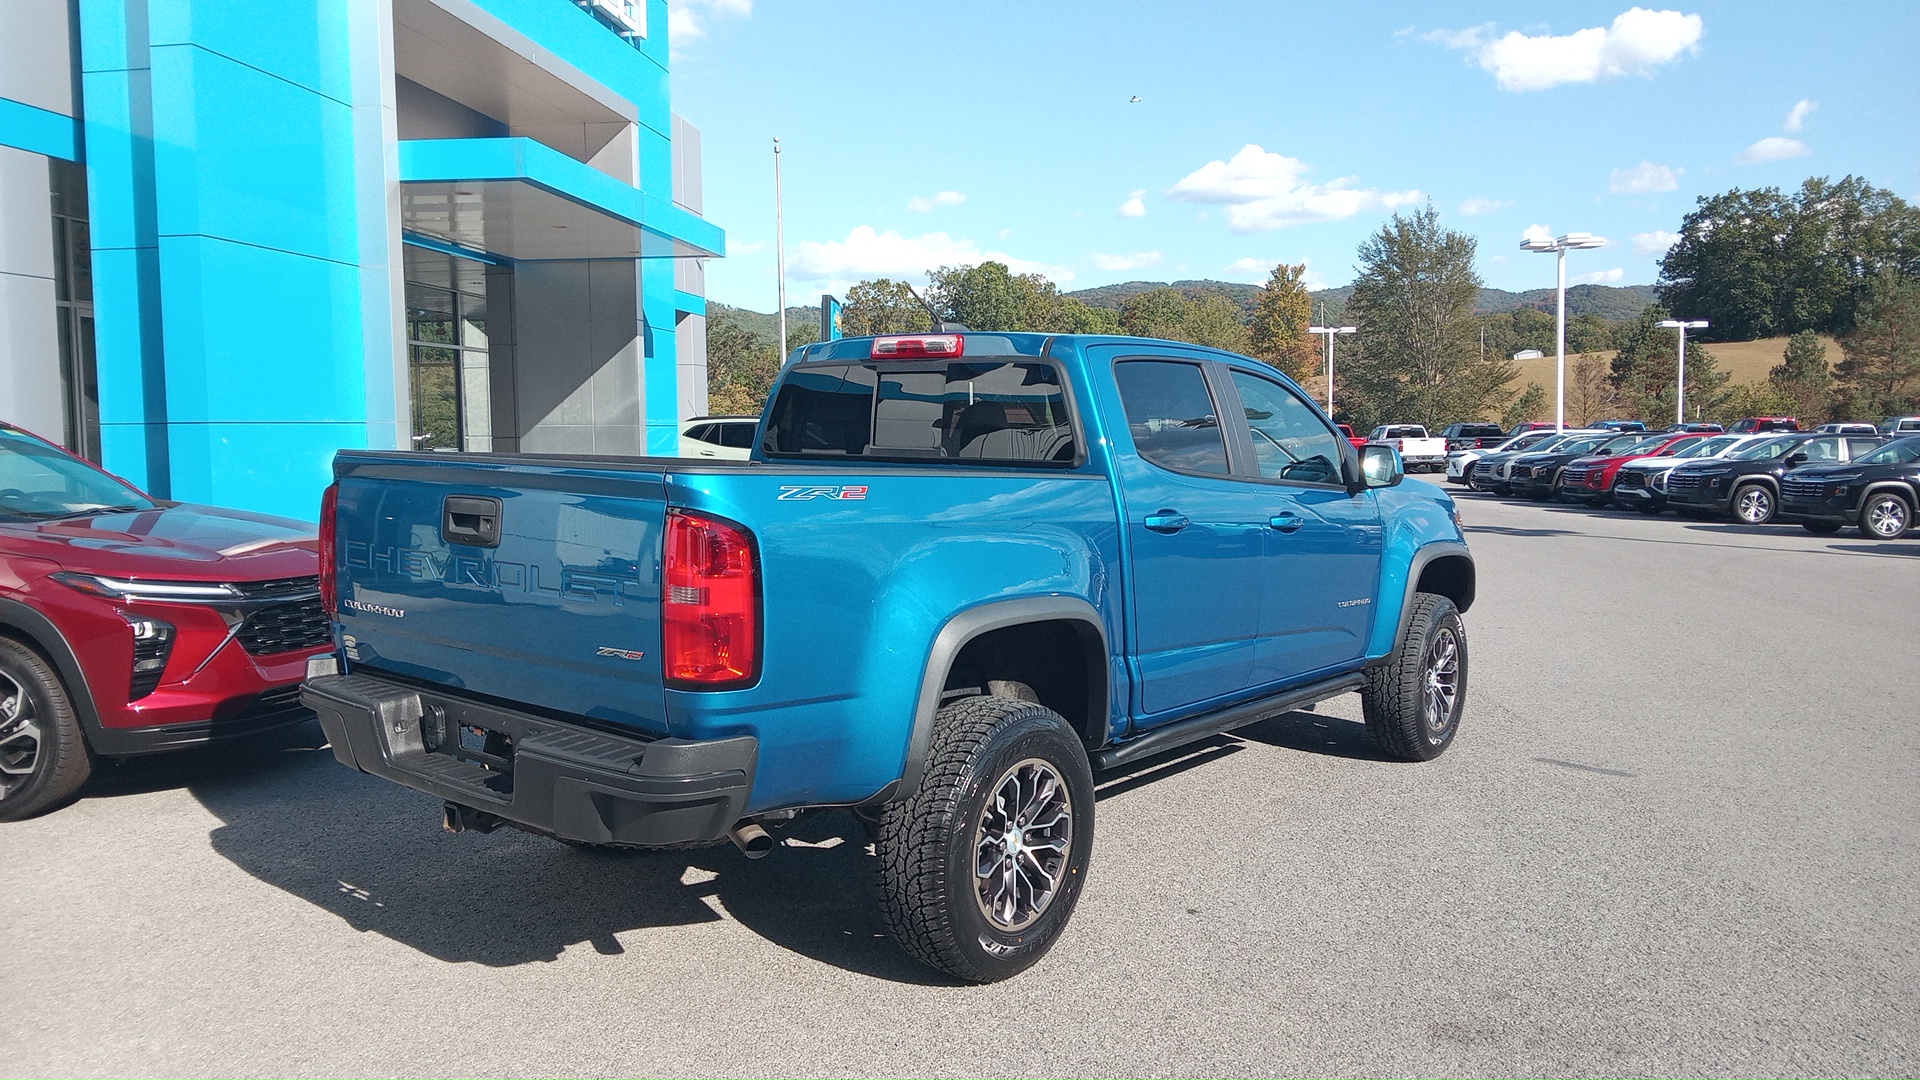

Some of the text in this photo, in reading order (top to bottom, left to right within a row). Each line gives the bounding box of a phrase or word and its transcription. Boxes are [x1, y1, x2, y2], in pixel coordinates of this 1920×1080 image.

[777, 485, 869, 501] ZR2
[345, 540, 640, 607] CHEVROLET
[596, 646, 644, 660] ZR2
